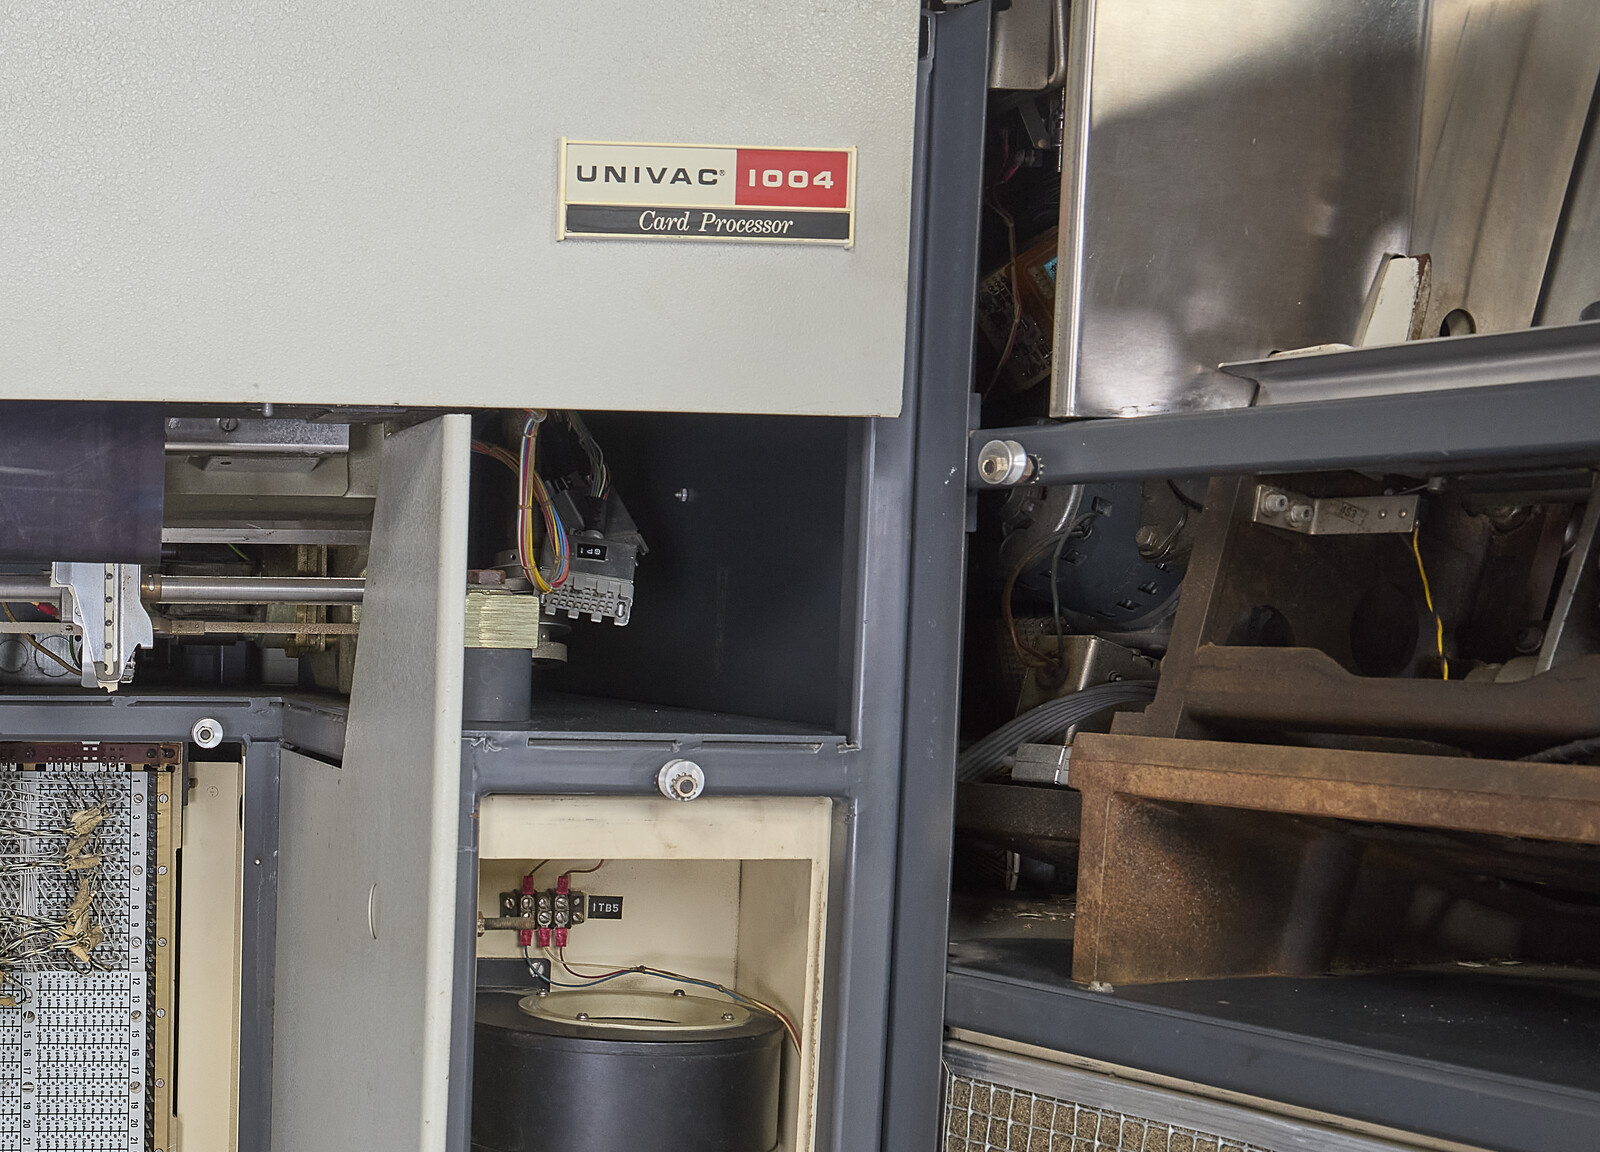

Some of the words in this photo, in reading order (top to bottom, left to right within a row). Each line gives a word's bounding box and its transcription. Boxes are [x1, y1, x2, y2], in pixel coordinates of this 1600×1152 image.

[748, 168, 834, 189] 1004
[638, 210, 690, 232] Card
[698, 212, 793, 234] Processor
[24, 978, 32, 986] 12
[132, 977, 140, 985] 12
[132, 995, 140, 1003] 13
[23, 1030, 32, 1038] 15
[132, 1030, 140, 1038] 15
[23, 1049, 31, 1057] 16
[23, 1067, 31, 1075] 17
[23, 1102, 31, 1110] 19
[131, 1101, 139, 1109] 19
[23, 1119, 31, 1128] 20
[130, 1119, 138, 1128] 20
[23, 1137, 31, 1145] 21
